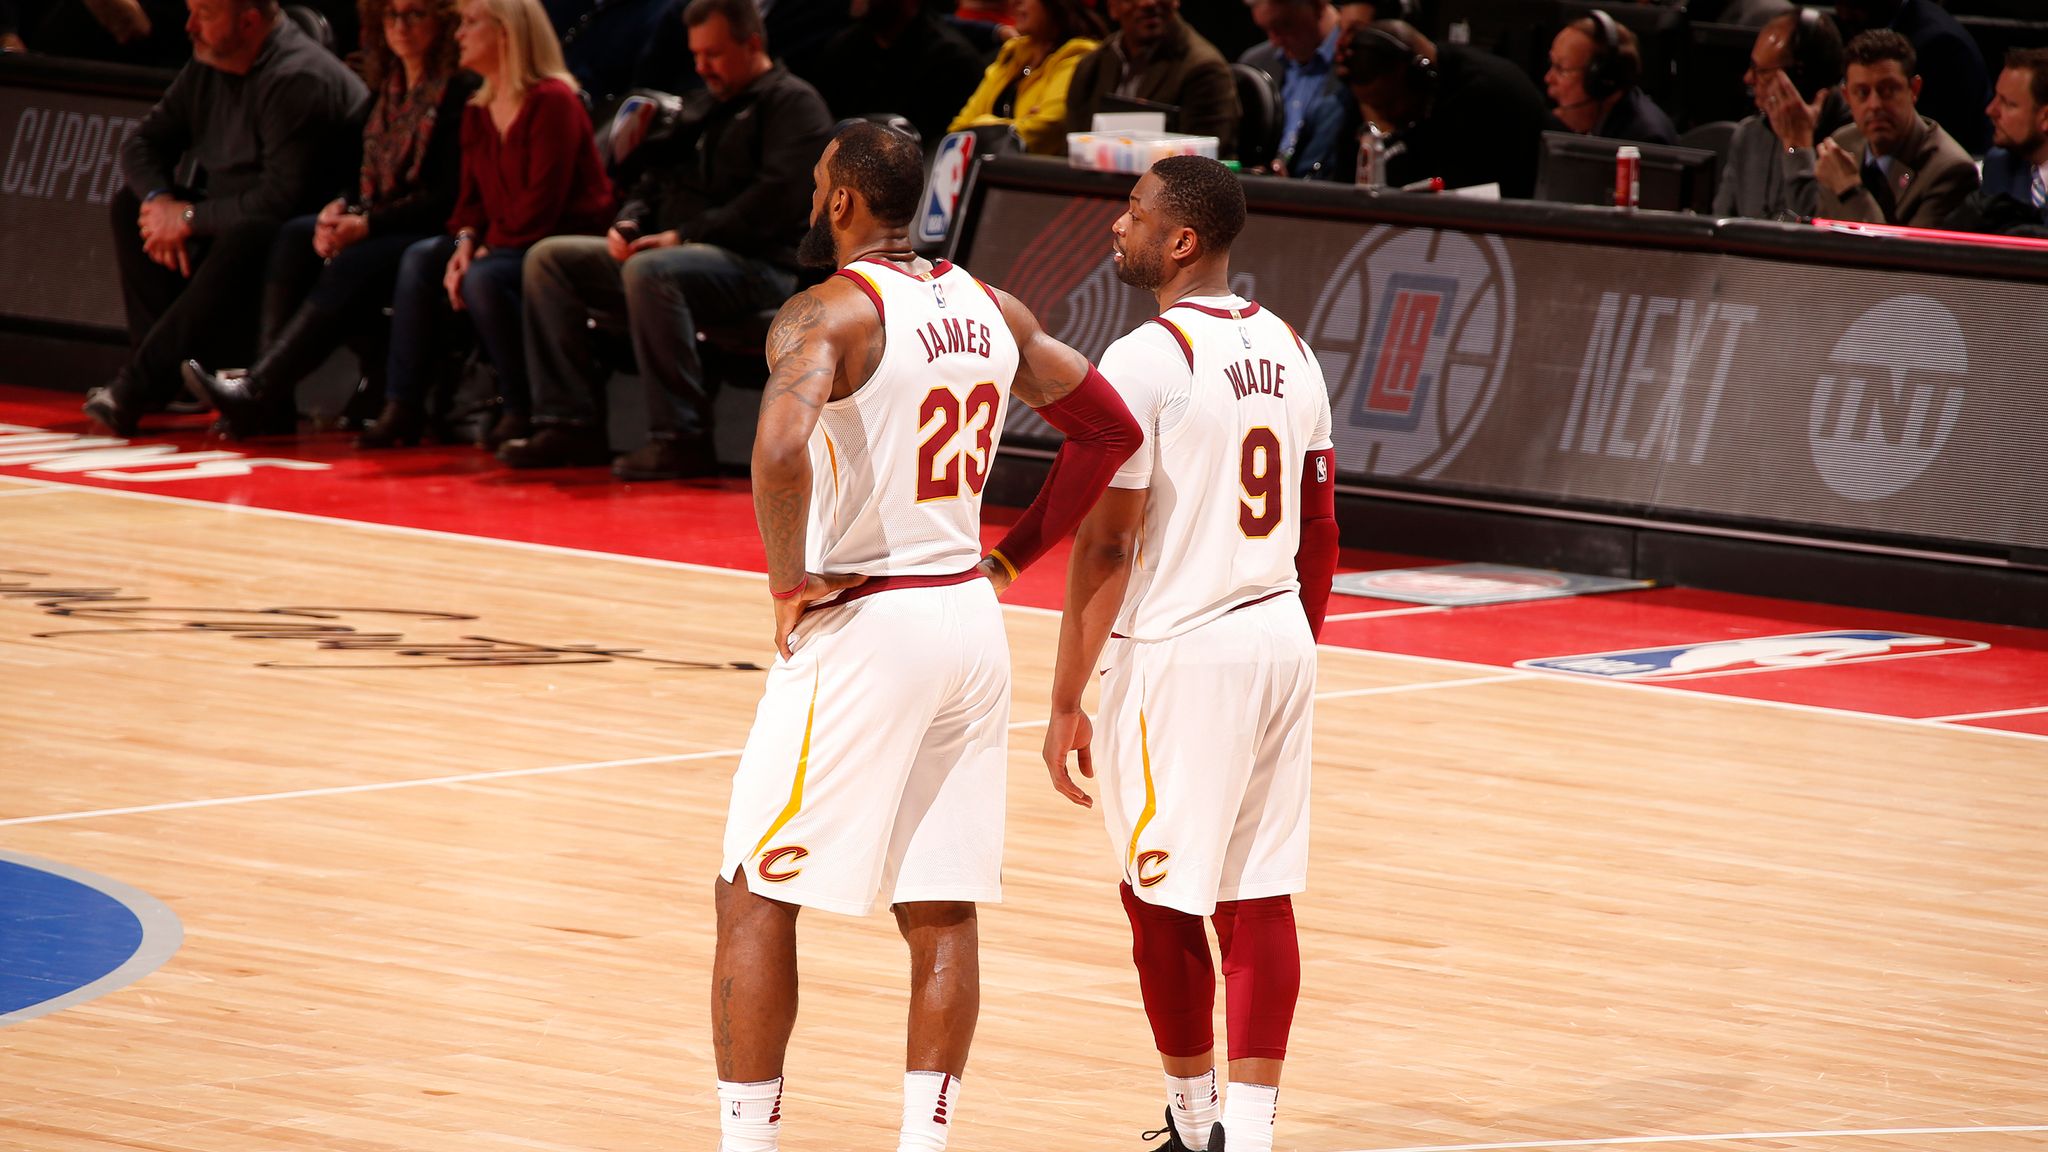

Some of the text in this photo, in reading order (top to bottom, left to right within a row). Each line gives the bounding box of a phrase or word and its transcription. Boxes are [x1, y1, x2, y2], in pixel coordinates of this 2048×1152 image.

[916, 317, 991, 364] JAMES
[1223, 358, 1286, 401] WADE
[1558, 291, 1759, 465] NEXT
[915, 379, 1001, 504] 23
[1237, 425, 1284, 540] 9
